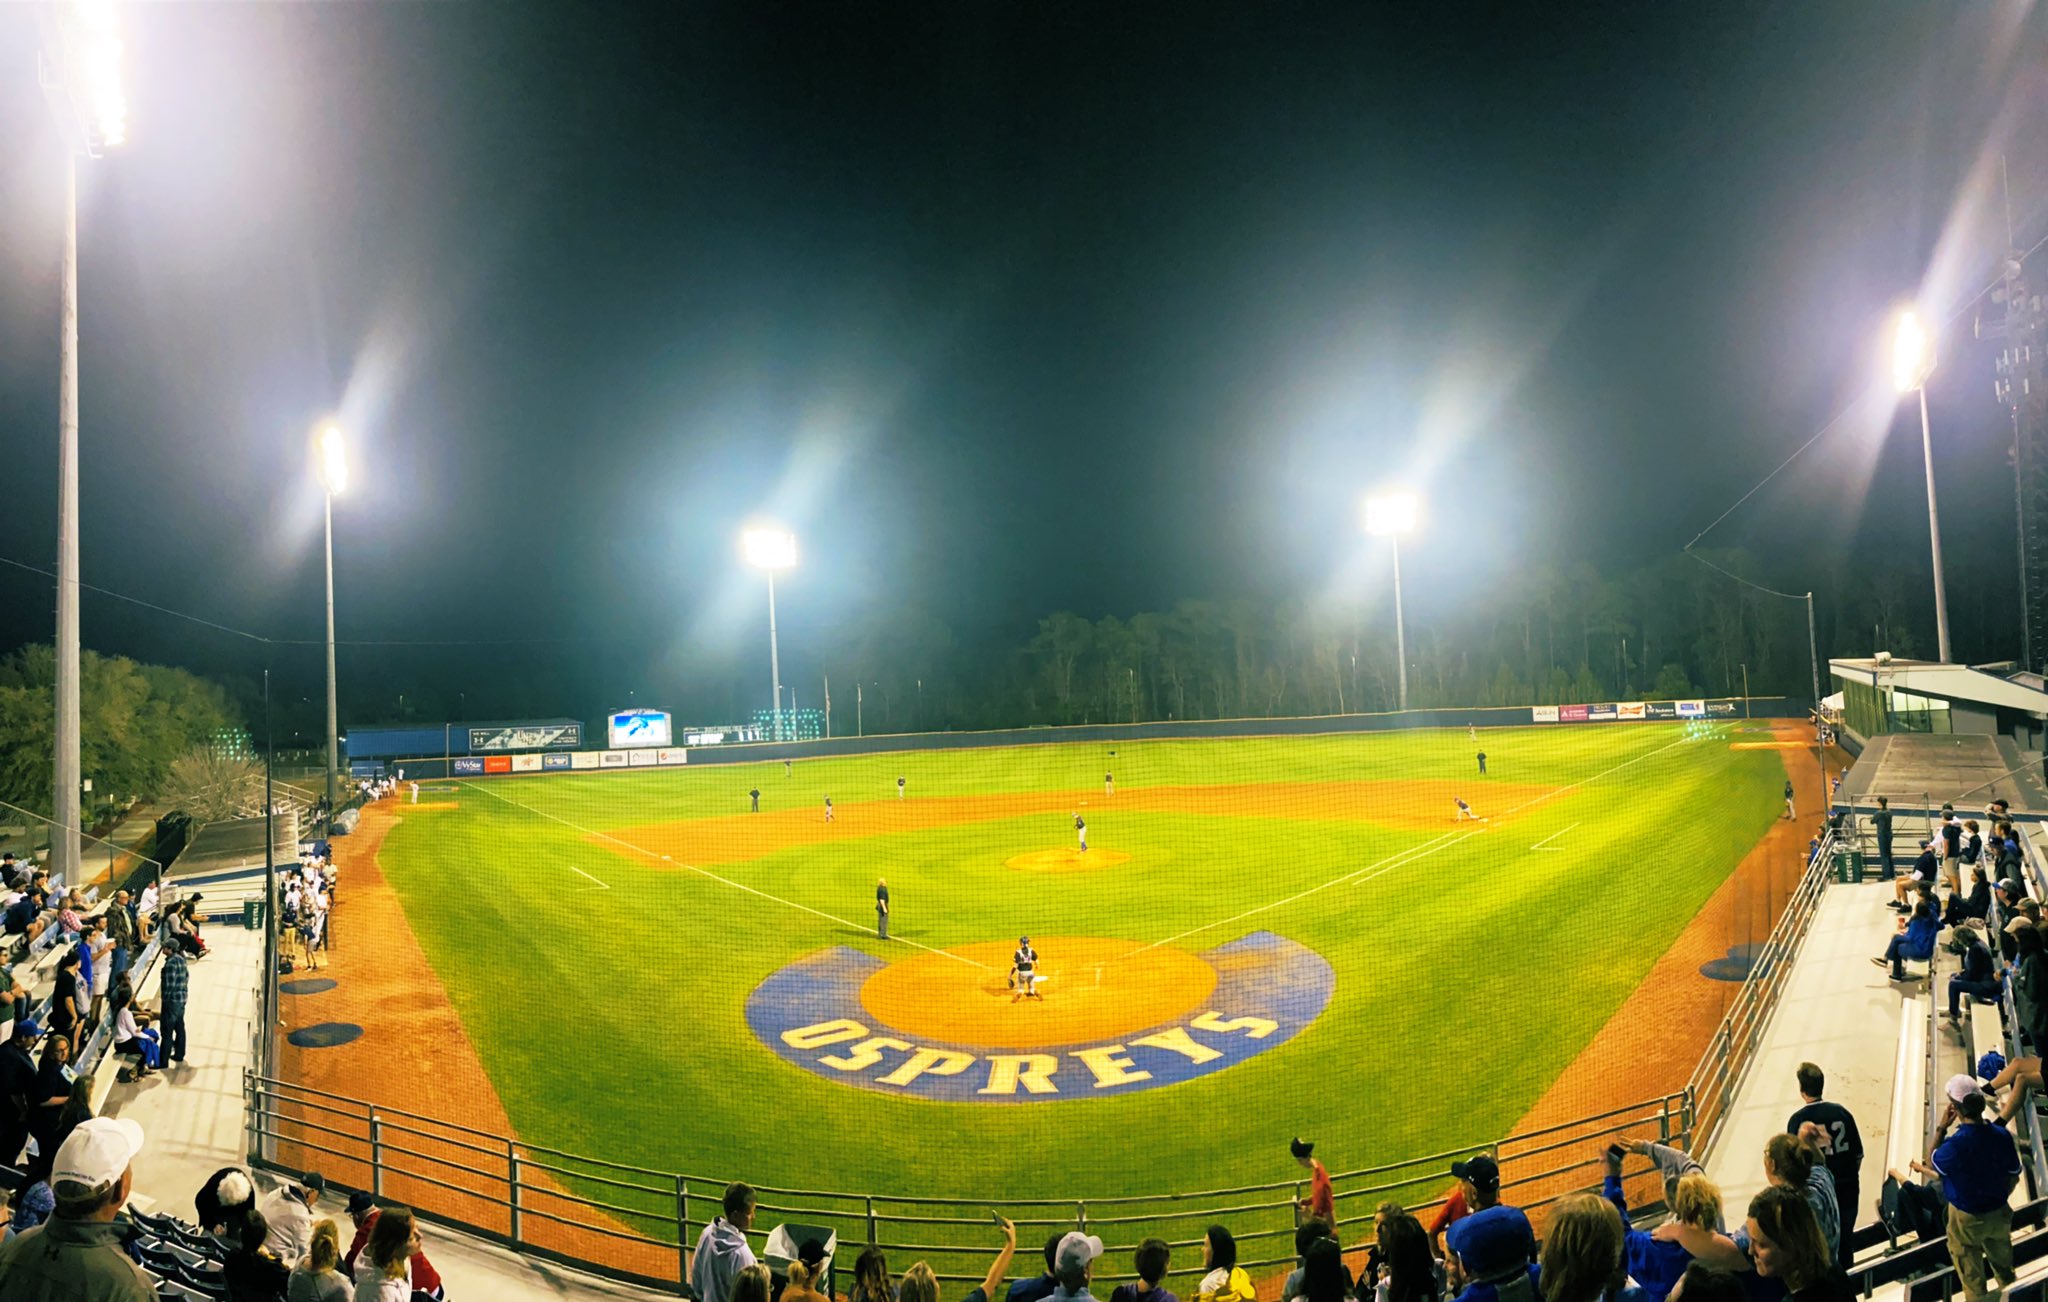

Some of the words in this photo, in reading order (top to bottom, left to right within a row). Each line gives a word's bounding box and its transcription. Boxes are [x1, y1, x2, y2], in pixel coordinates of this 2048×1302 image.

[462, 760, 481, 769] VyStar
[1845, 854, 1854, 882] RECYCLE
[780, 1010, 1279, 1096] OSPREYS
